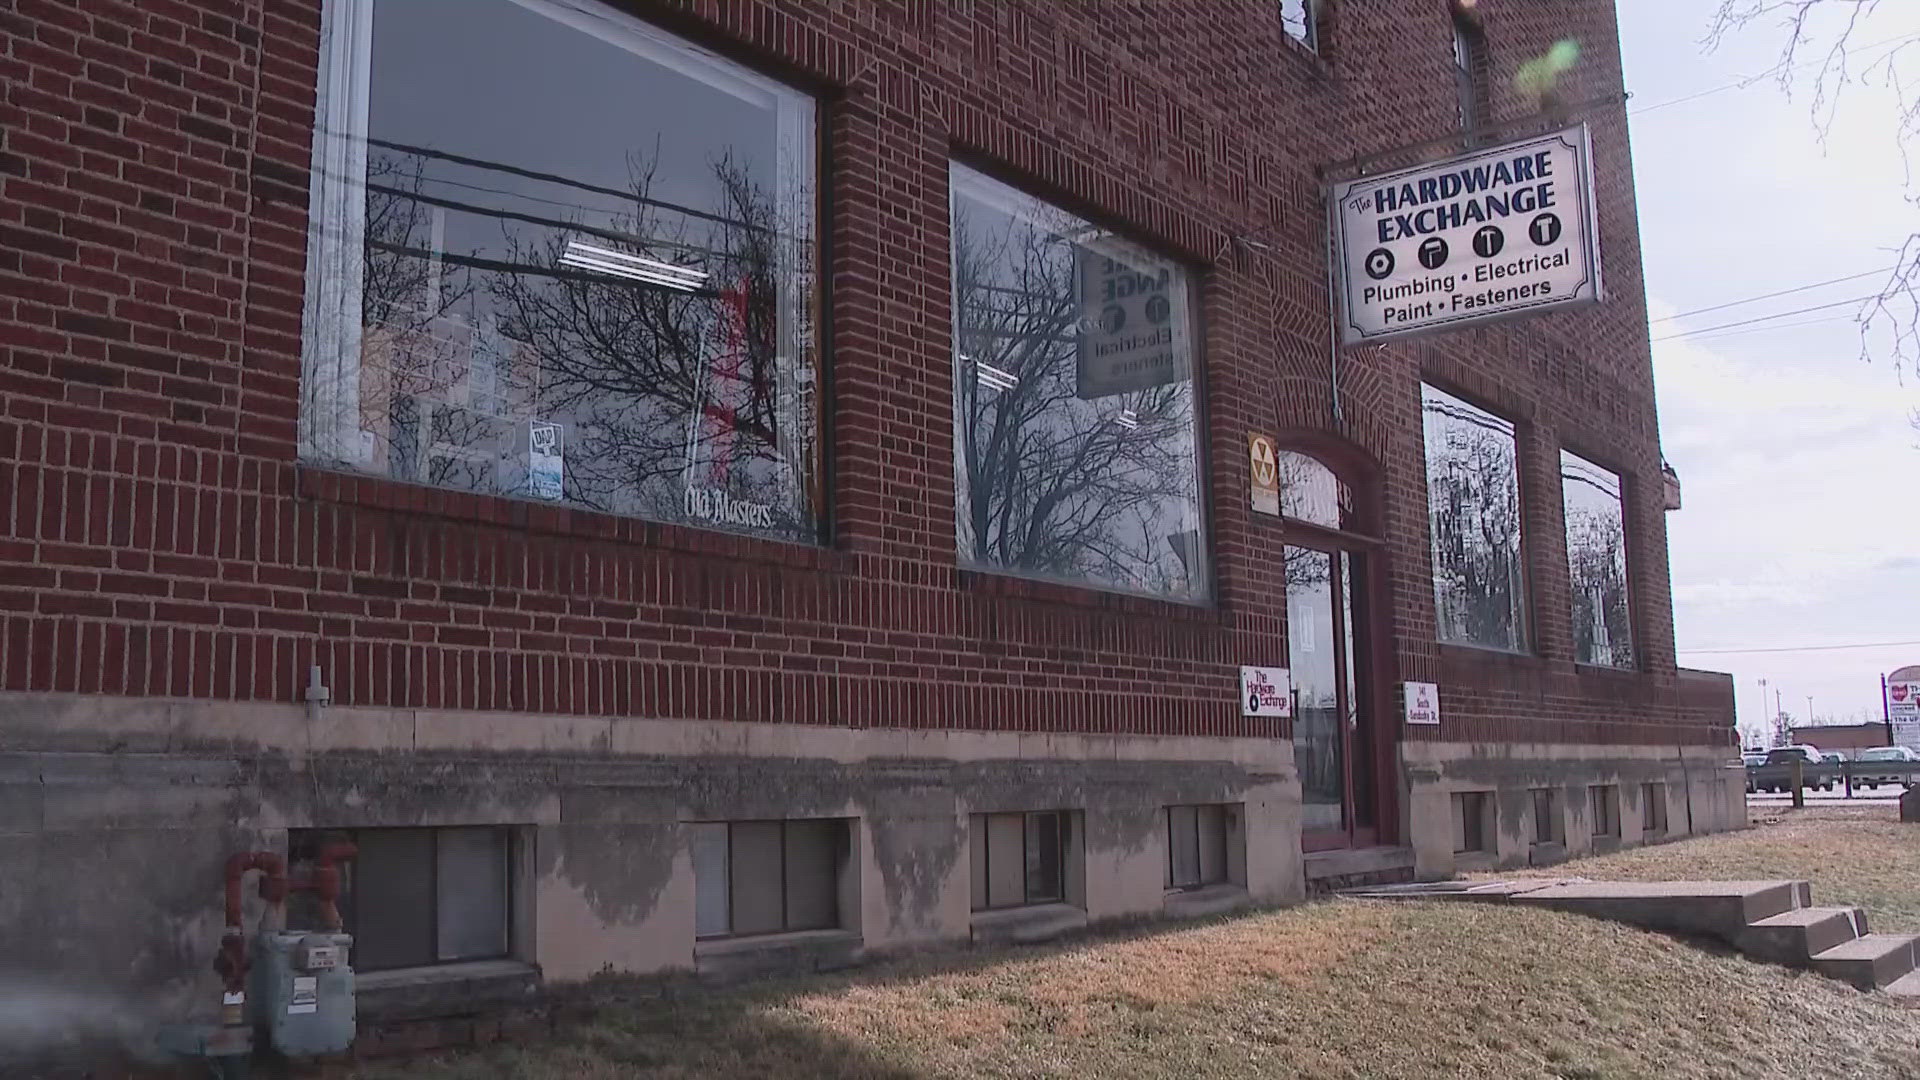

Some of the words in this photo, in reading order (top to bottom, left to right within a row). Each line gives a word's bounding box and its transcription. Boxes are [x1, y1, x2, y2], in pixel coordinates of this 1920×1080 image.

[1349, 196, 1373, 215] The
[1374, 151, 1553, 214] HARDWARE
[1377, 181, 1557, 244] EXCHANGE
[1363, 272, 1456, 305] Plumbing
[1474, 247, 1571, 283] Electrical
[1383, 300, 1434, 325] Paint
[1451, 280, 1552, 313] Fasteners
[533, 427, 554, 446] DAP
[684, 484, 712, 520] Old
[711, 488, 774, 529] Masters
[1254, 669, 1268, 684] The
